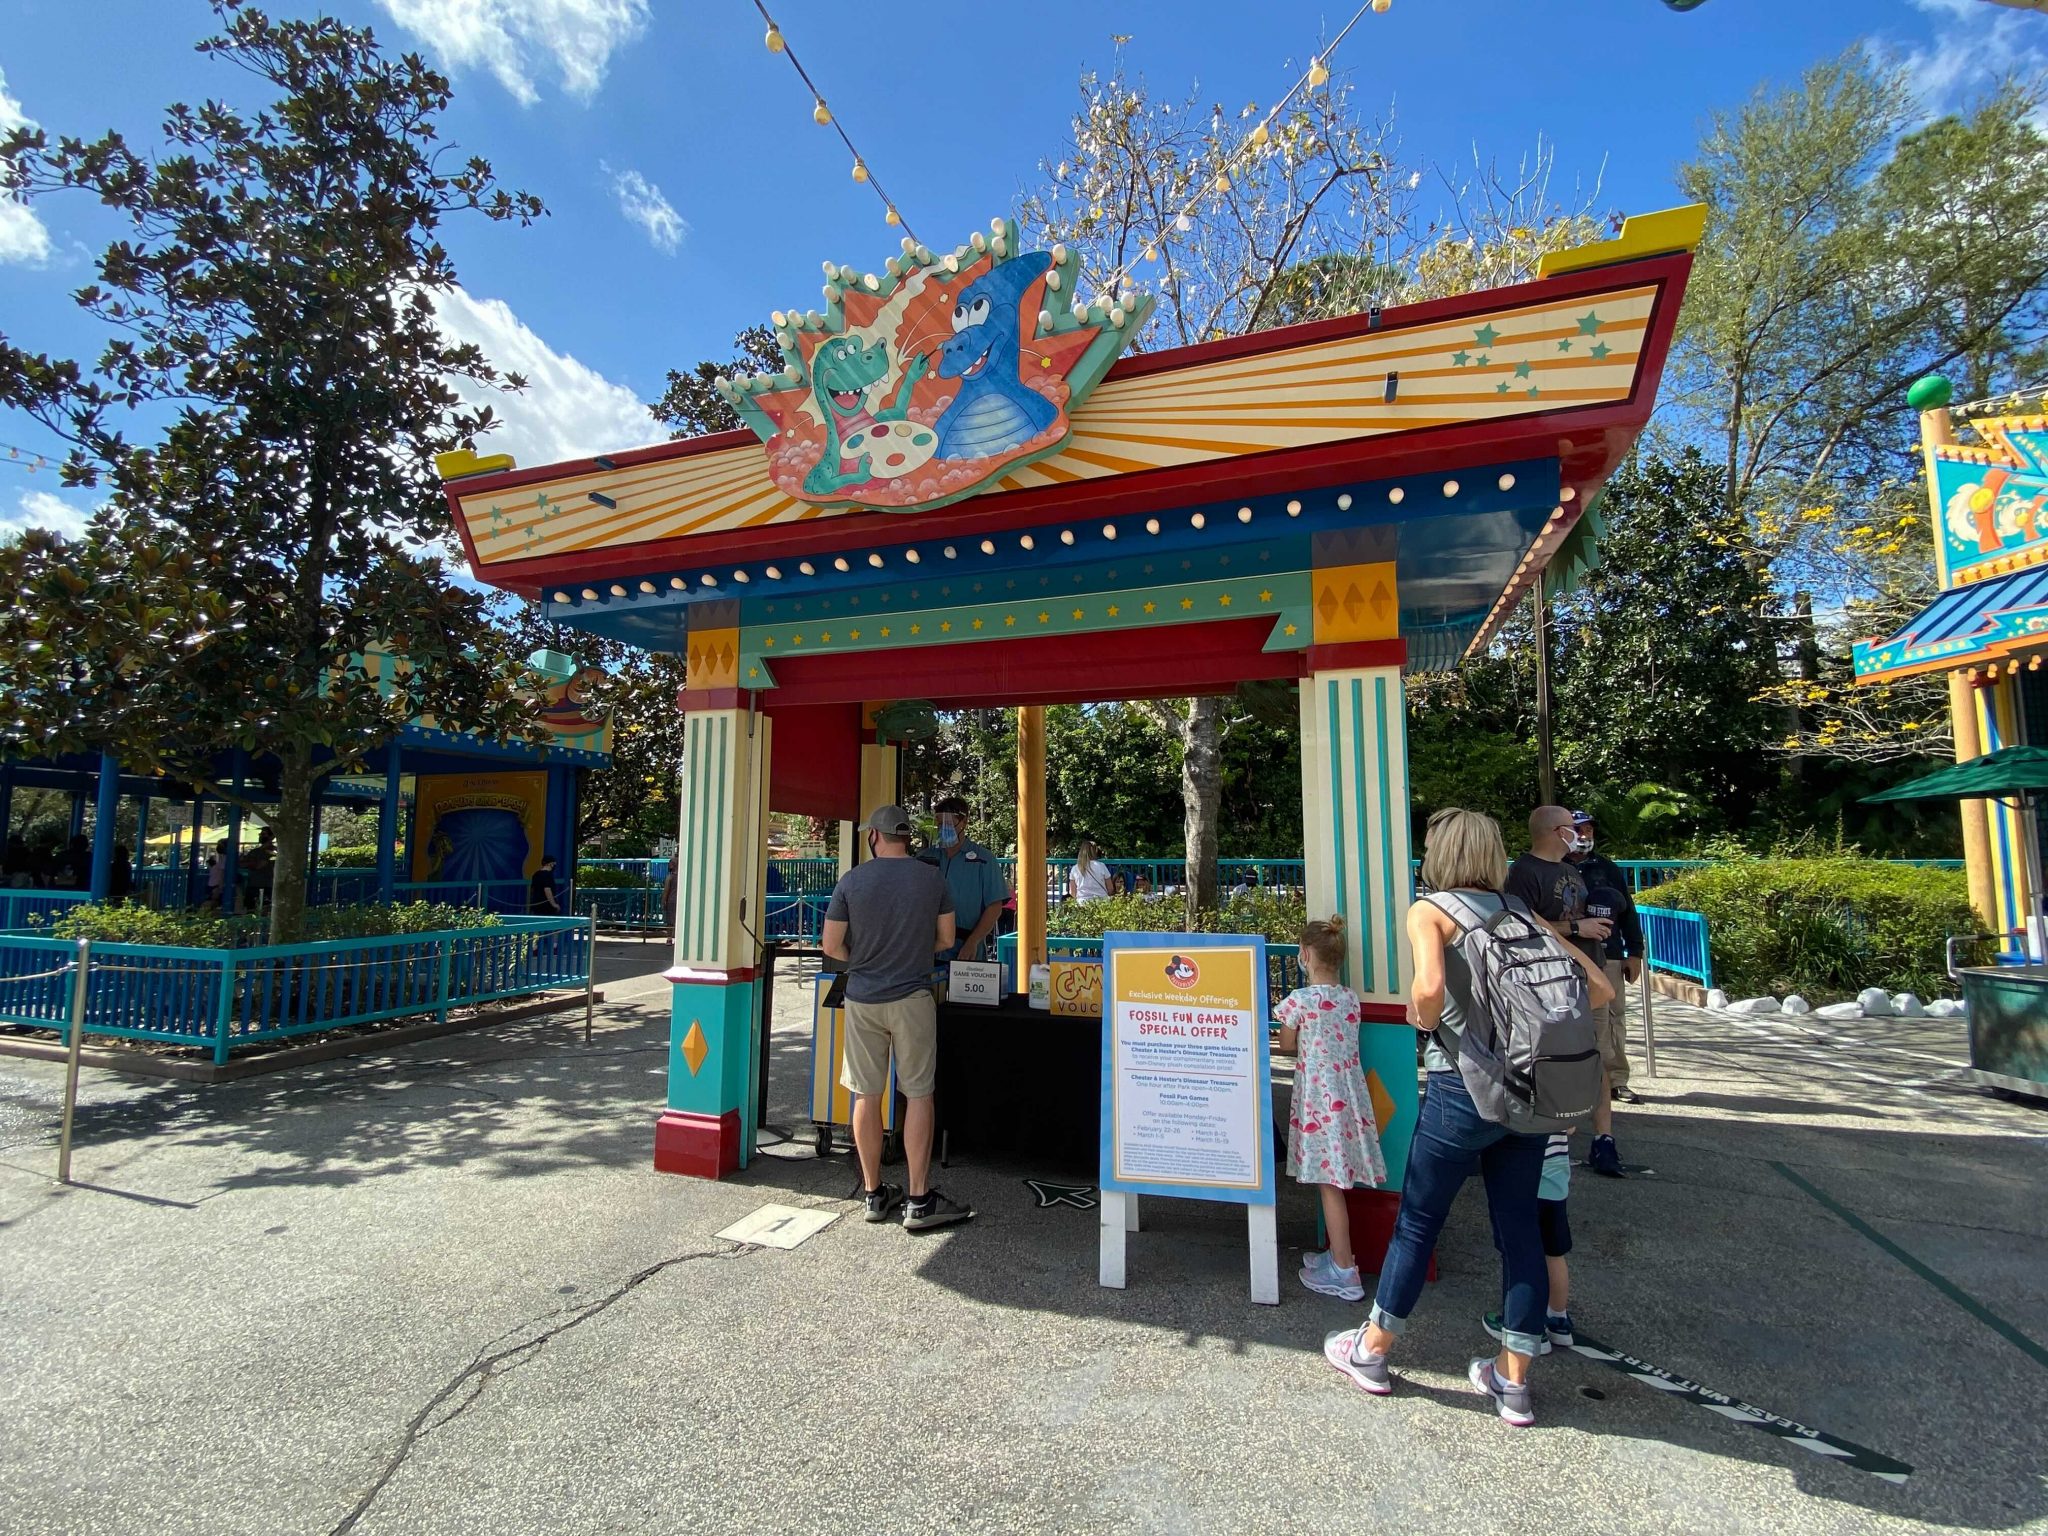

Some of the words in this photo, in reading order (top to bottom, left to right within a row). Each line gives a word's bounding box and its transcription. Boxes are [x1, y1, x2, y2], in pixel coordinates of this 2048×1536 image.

[662, 847, 673, 857] 25
[964, 983, 985, 993] 5.00
[1056, 964, 1103, 1001] GAM
[1129, 990, 1163, 1000] Exclusive
[1165, 992, 1198, 1005] Weekday
[1200, 995, 1238, 1007] Offerings
[1058, 1001, 1099, 1013] VOUC
[1129, 1010, 1168, 1022] FOSSIL
[1173, 1012, 1193, 1024] FUN
[1197, 1014, 1239, 1026] GAMES
[1140, 1024, 1187, 1036] SPECIAL
[1191, 1027, 1228, 1040] OFFER
[1210, 1079, 1238, 1087] Treasures
[1137, 1125, 1162, 1133] February
[1172, 1119, 1198, 1127] following
[1609, 1350, 1673, 1380] HERE
[1675, 1380, 1731, 1405] WAIT
[1735, 1402, 1821, 1439] PLEASE
